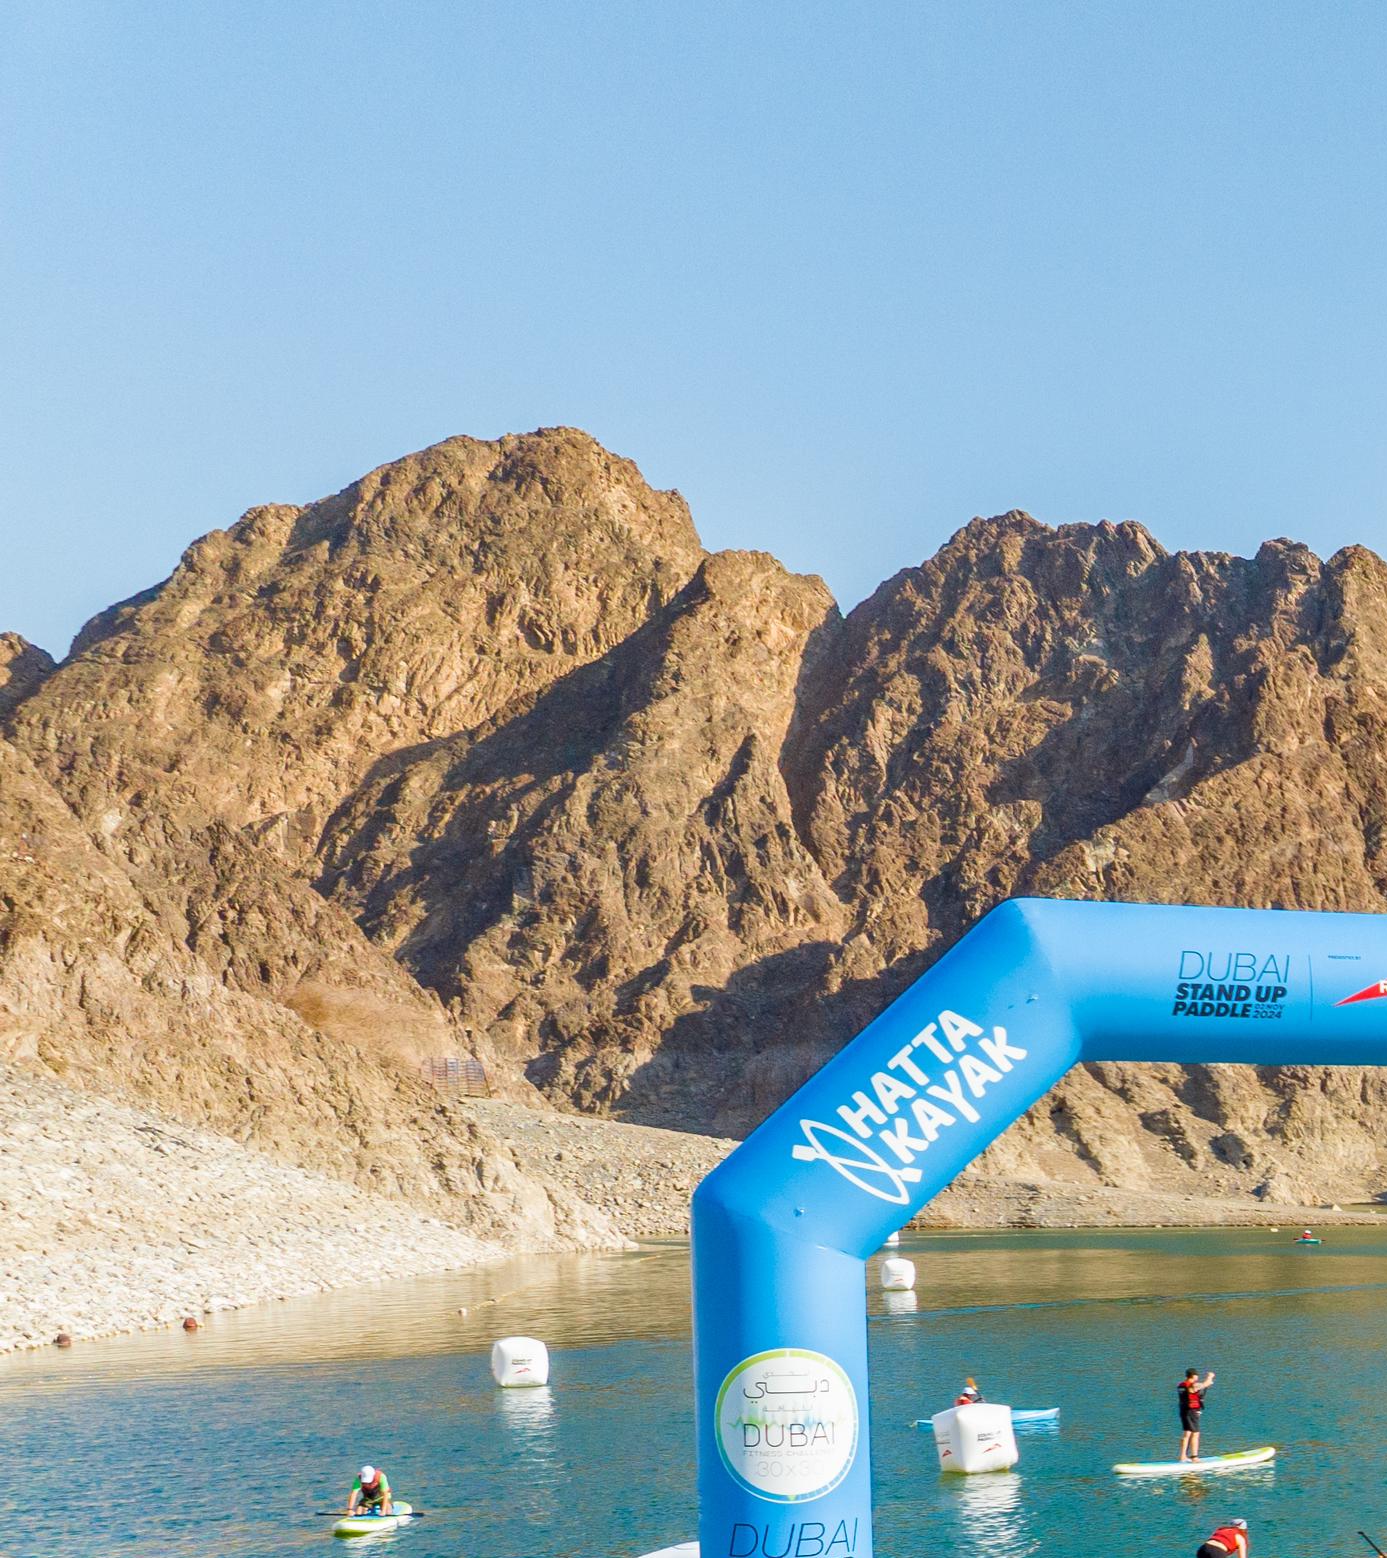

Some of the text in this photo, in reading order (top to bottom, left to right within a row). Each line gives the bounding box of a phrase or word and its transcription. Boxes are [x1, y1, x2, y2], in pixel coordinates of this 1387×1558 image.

[1178, 950, 1290, 983] DUBAI
[1176, 983, 1287, 1003] STAND UP
[1173, 1002, 1251, 1019] PADDLE
[1253, 1010, 1282, 1020] 2024
[1267, 1003, 1285, 1012] NOV
[836, 1010, 984, 1138] HATTA
[879, 1026, 1028, 1164] KAYAK
[743, 1379, 830, 1404] دبي
[743, 1421, 835, 1448] DUBAI
[729, 1517, 858, 1558] DUBAI
